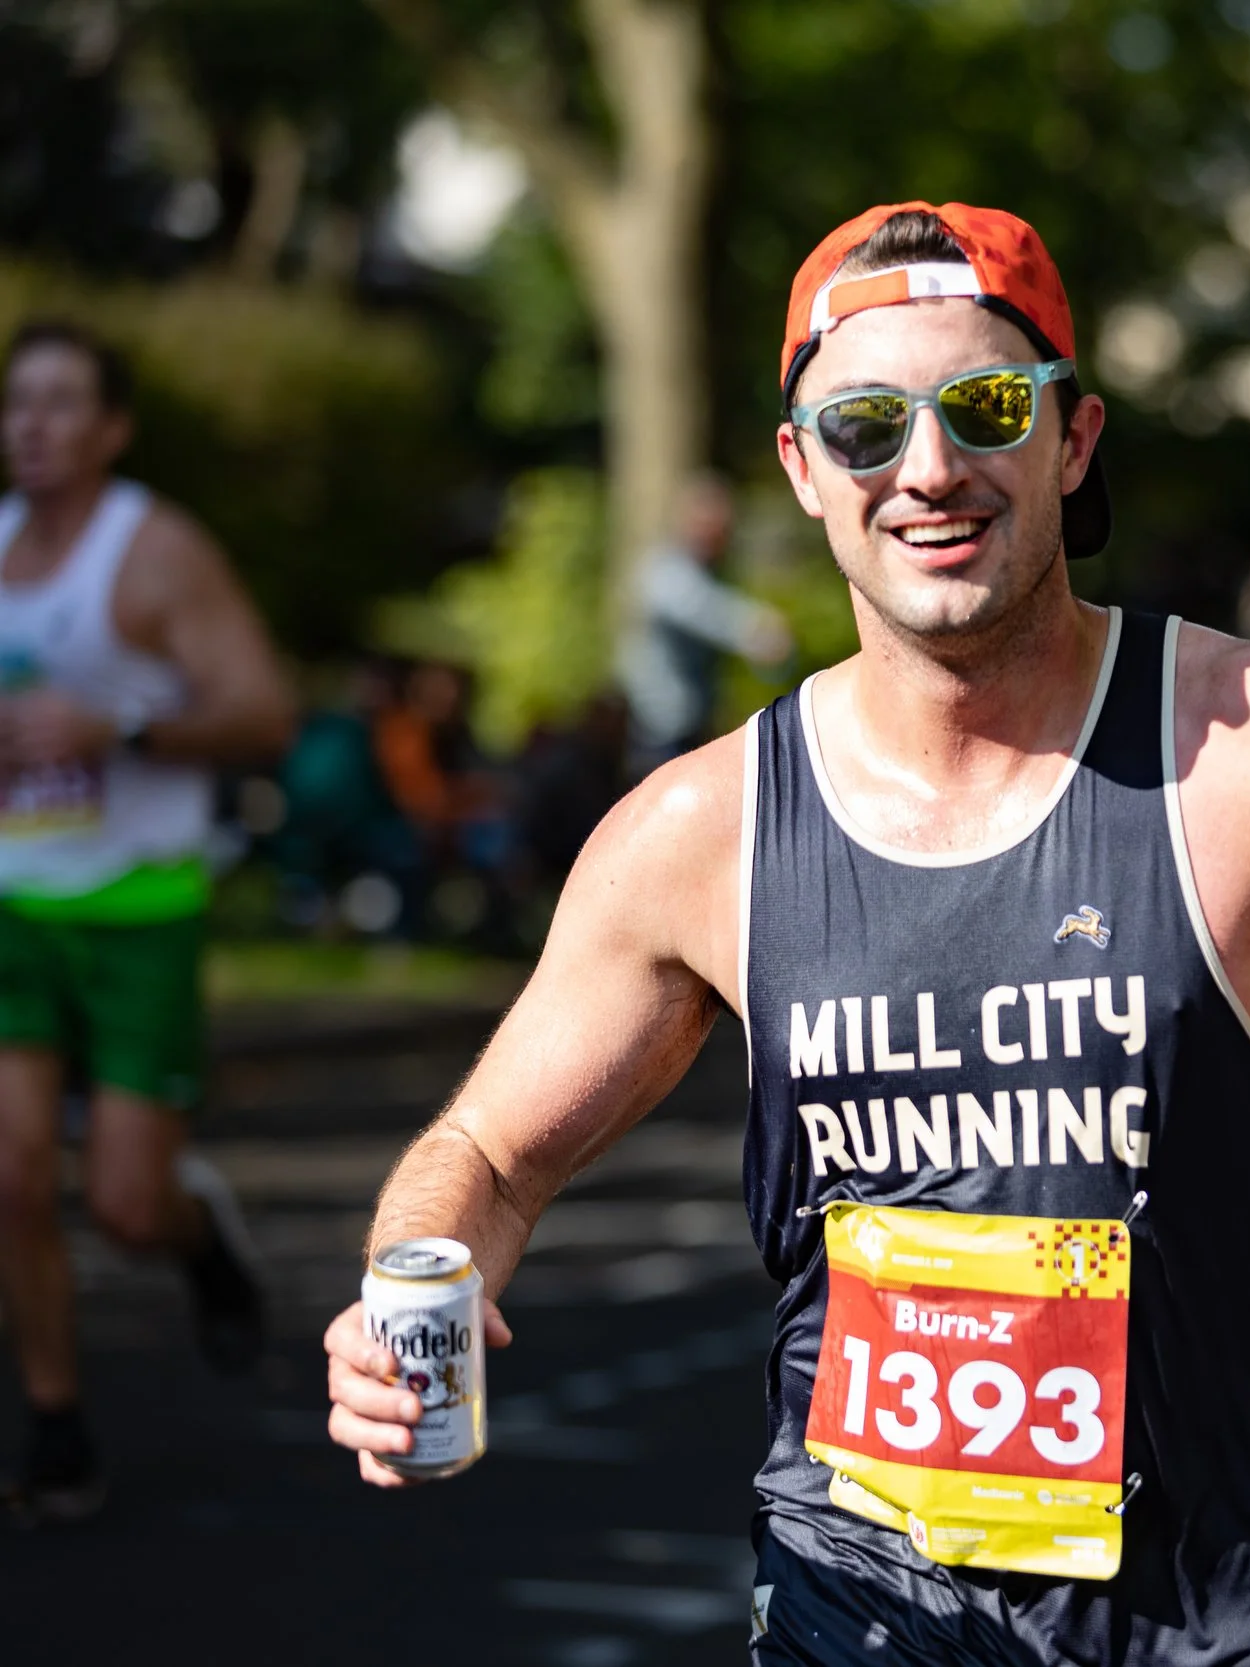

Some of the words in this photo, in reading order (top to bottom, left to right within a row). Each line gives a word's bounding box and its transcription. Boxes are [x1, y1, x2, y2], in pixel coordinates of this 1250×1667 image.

[790, 992, 962, 1079] MILL
[980, 974, 1146, 1064] CITY
[798, 1086, 1151, 1177] RUNNING
[370, 1311, 472, 1359] Modelo
[894, 1300, 1015, 1344] Burn-Z
[842, 1334, 1105, 1465] 1393
